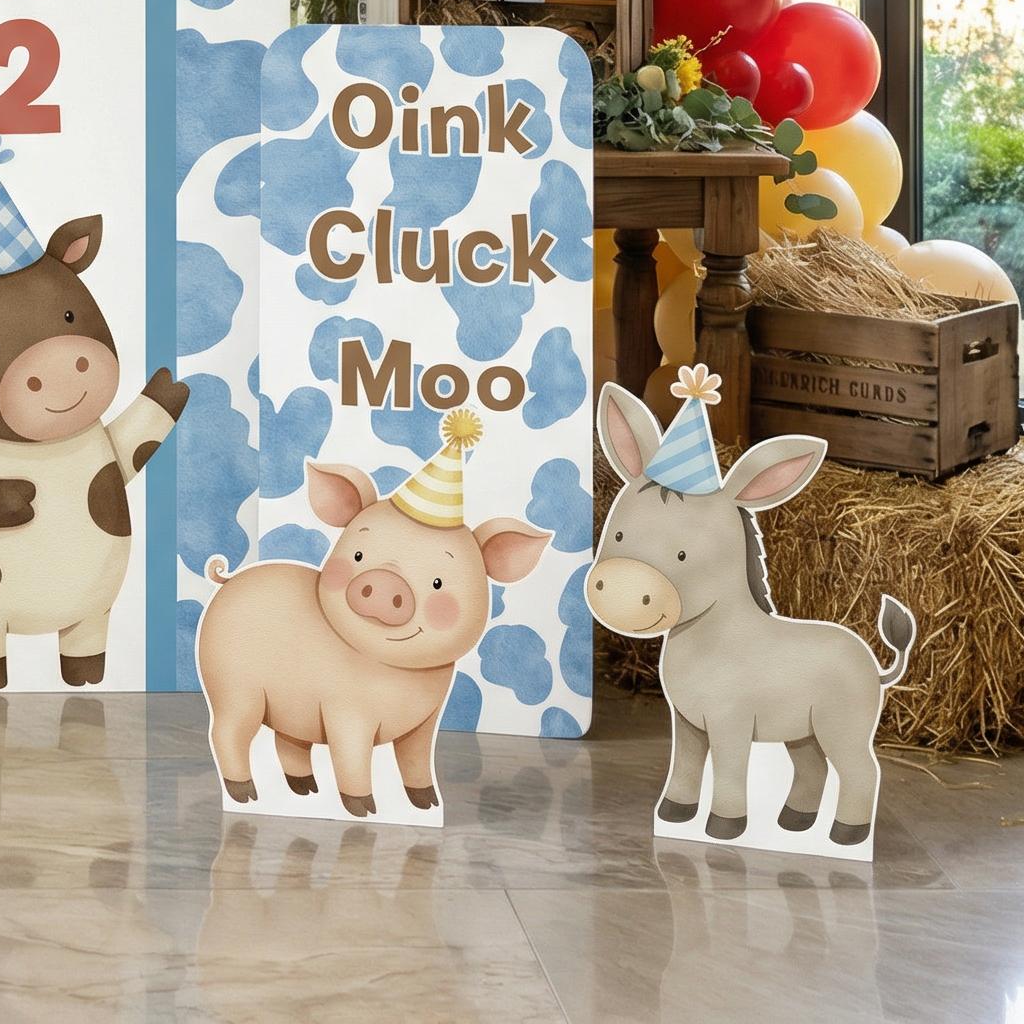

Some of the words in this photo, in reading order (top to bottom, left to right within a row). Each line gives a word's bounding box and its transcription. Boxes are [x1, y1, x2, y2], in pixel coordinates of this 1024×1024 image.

[332, 82, 534, 155] Oink
[309, 208, 557, 284] Cluck
[341, 338, 525, 412] Moo
